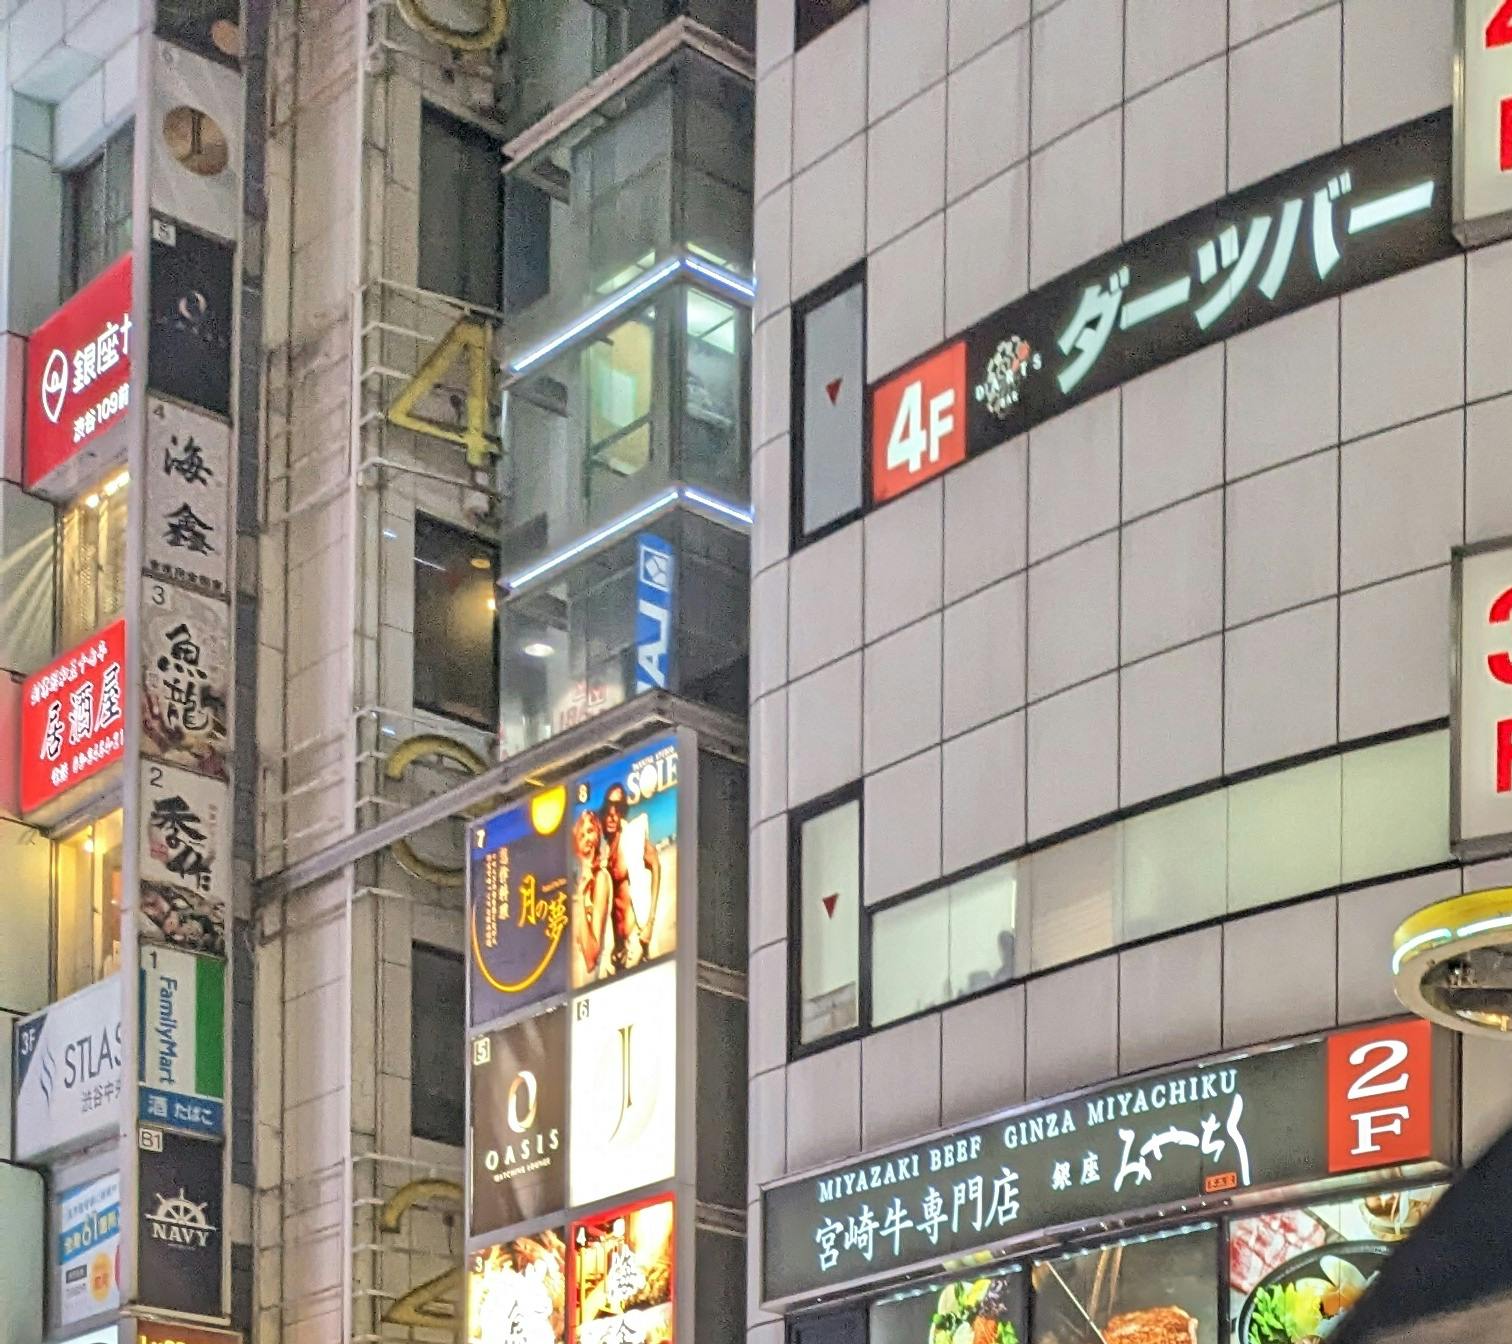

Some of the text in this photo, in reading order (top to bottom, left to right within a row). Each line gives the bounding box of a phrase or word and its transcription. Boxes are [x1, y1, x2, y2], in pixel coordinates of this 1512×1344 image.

[1057, 171, 1434, 395] ダーツバー
[886, 380, 956, 473] 4F
[152, 585, 165, 605] 3
[150, 767, 163, 788] 2
[578, 784, 588, 803] 8
[149, 952, 158, 969] 1
[20, 1028, 37, 1055] 3F
[157, 975, 178, 1086] FamilyMart
[1346, 1038, 1412, 1156] 2F
[141, 1130, 162, 1150] B1
[485, 1128, 560, 1171] OASIS
[818, 1069, 1239, 1203] MIYAZAKI BEEF GINZA MIYACHIKU
[1051, 1093, 1250, 1192] 銀座 みやちく
[152, 1222, 209, 1247] NAVY
[814, 1166, 1020, 1271] 宮崎牛専門店
[576, 1226, 587, 1247] 4
